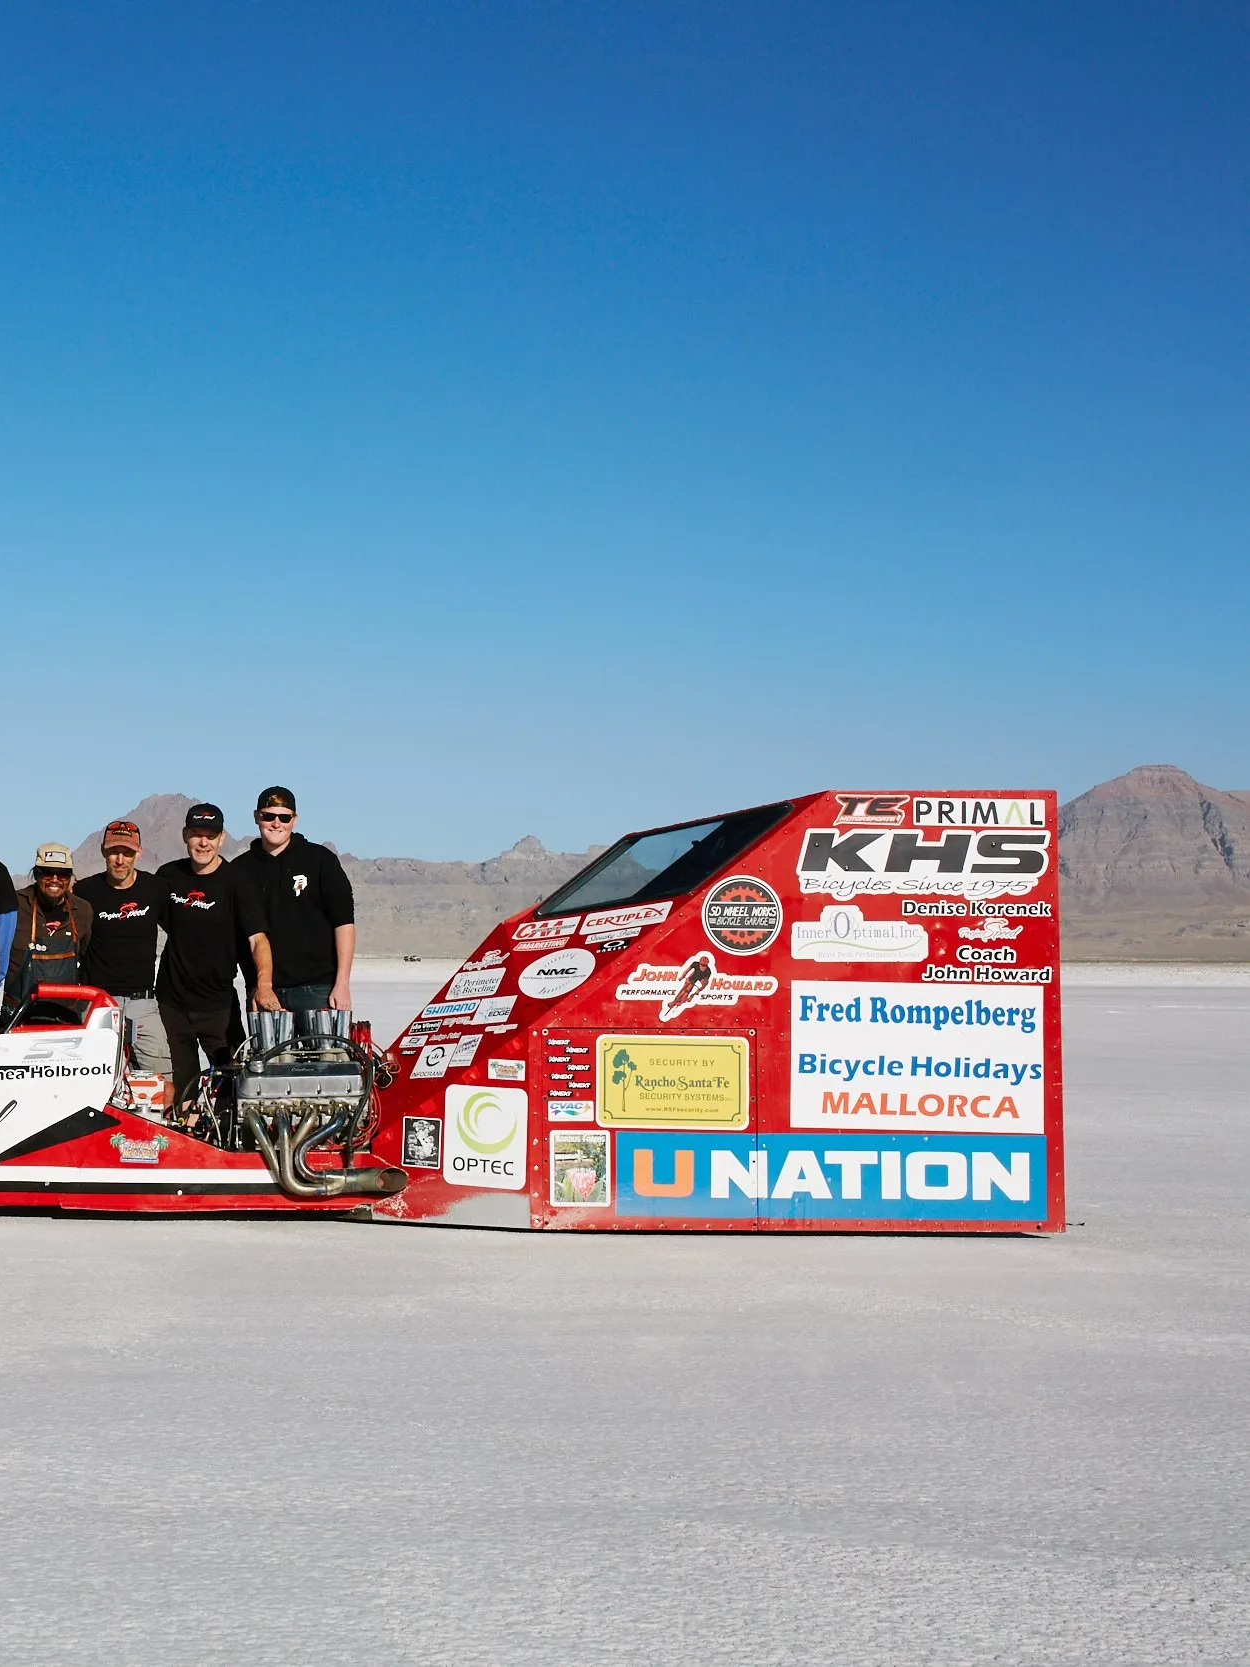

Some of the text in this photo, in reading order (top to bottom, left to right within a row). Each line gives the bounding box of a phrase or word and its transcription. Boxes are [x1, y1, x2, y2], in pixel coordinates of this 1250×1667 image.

[840, 797, 906, 816] TE
[915, 800, 1043, 825] PRIMAL
[800, 832, 1048, 874] KHS
[803, 874, 1036, 898] Bicycles Since 1975
[709, 906, 777, 917] SD WHEEL WORKS
[903, 901, 1050, 916] Denise Korenek
[586, 908, 666, 927] CERTIPLEX
[716, 917, 769, 926] BICYCLE GARAGE
[797, 926, 831, 939] Inner
[957, 947, 1015, 962] Coach
[536, 967, 578, 976] NMC
[923, 965, 1050, 982] John Howard
[462, 985, 496, 994] Bicycling
[464, 977, 500, 987] Perimeter
[424, 1002, 476, 1016] SHIMANO
[800, 995, 1036, 1034] Fred Rompelberg
[649, 1058, 715, 1067] SECURITY BY
[798, 1053, 1043, 1086] Bicycle Holidays
[31, 1063, 113, 1078] Holbrook
[635, 1075, 730, 1091] Rancho Santa Fe
[639, 1092, 682, 1100] SECURITY
[684, 1094, 725, 1102] SYSTEMS
[550, 1102, 584, 1110] CVAC
[822, 1091, 1020, 1119] MALLORCA
[453, 1157, 514, 1176] OPTEC
[633, 1149, 1030, 1201] U NATION
